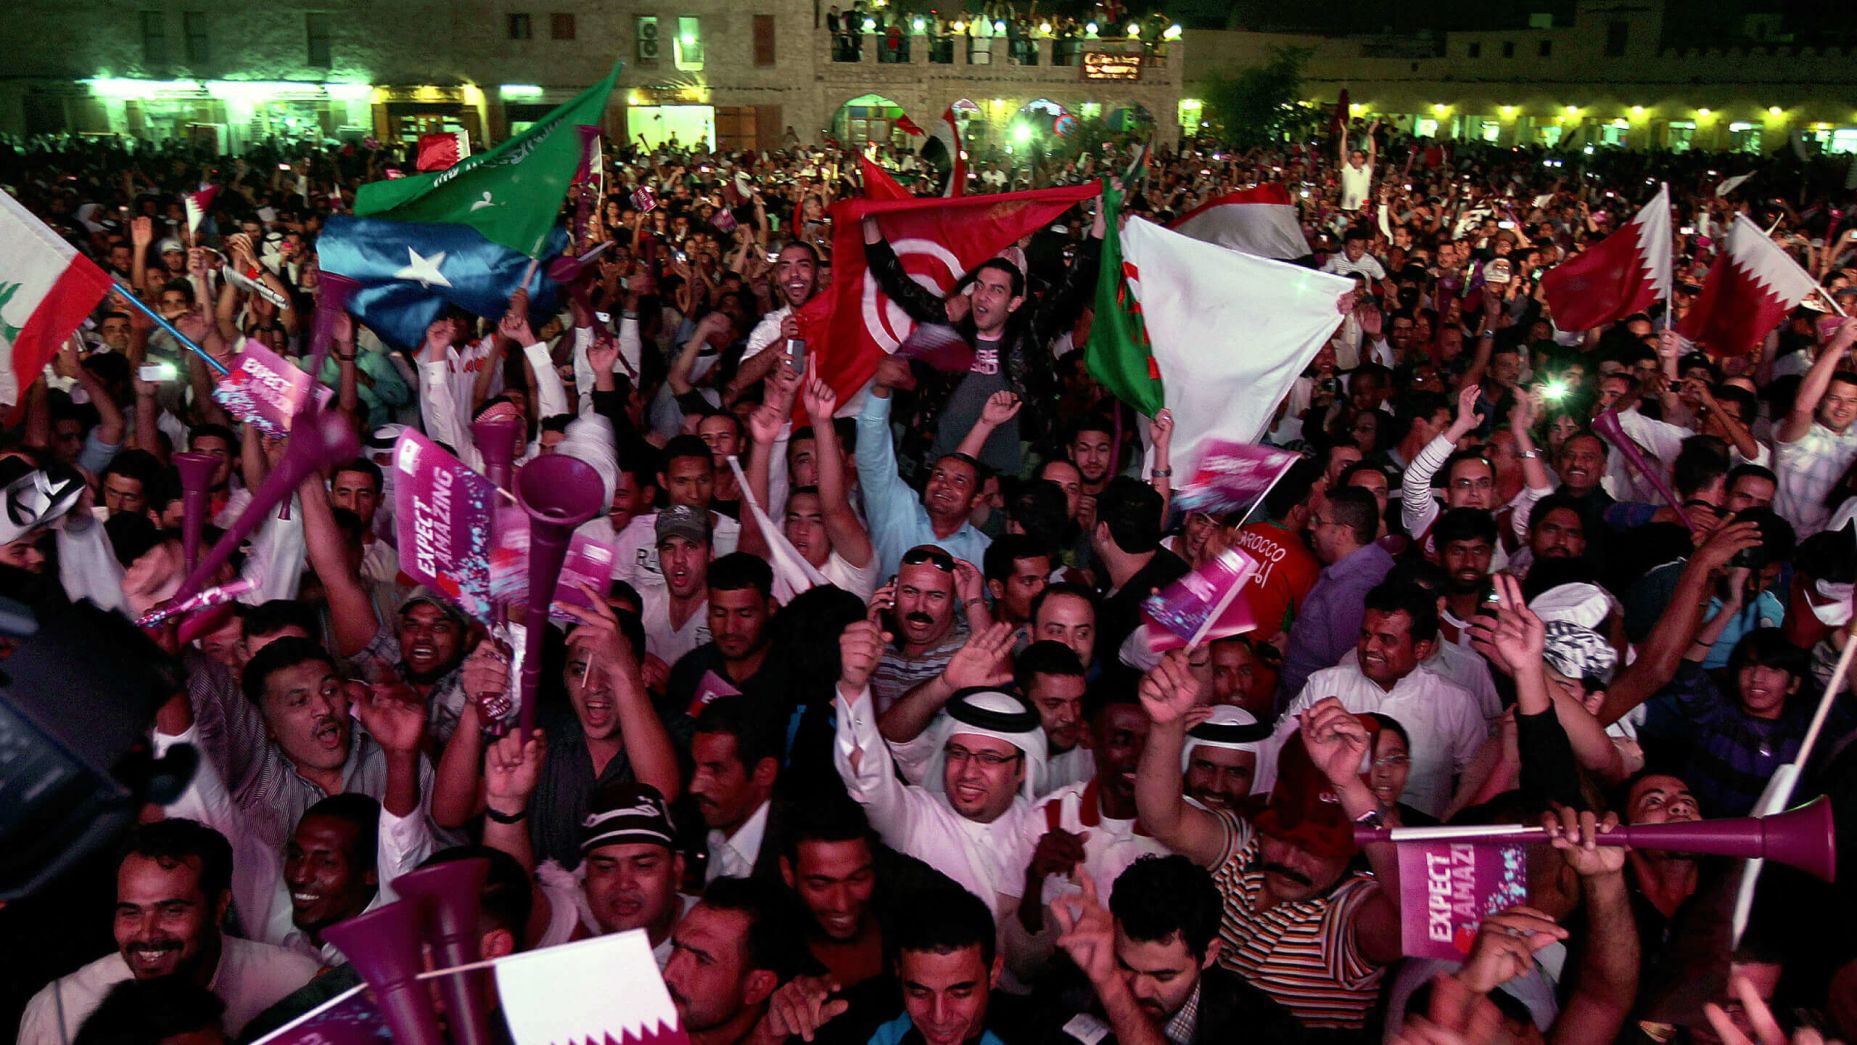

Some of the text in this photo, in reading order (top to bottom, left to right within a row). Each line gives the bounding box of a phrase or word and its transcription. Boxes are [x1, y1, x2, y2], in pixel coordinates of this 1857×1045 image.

[413, 496, 437, 578] EXPECT
[433, 467, 454, 570] AMAZING
[1238, 530, 1287, 563] AROCCO
[1426, 852, 1453, 943] EXPECT
[1450, 843, 1477, 919] AMAZI
